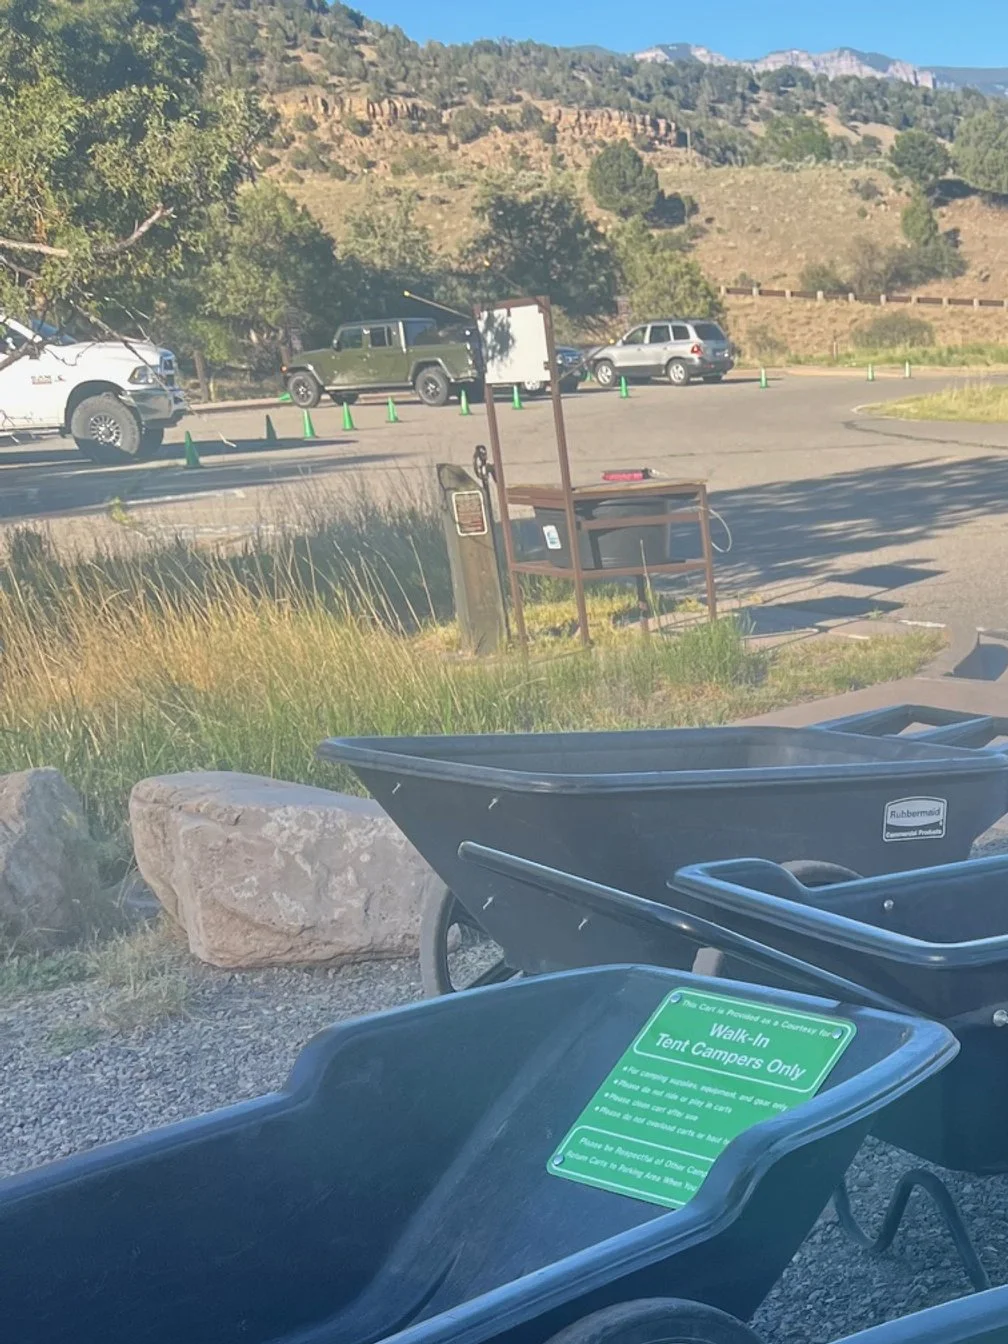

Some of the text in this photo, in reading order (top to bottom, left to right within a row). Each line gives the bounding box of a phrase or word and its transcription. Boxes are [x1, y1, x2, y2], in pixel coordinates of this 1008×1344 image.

[890, 807, 941, 819] Rubbermaid
[709, 1022, 770, 1048] Walk-In
[655, 1032, 807, 1081] Tent Campers Only
